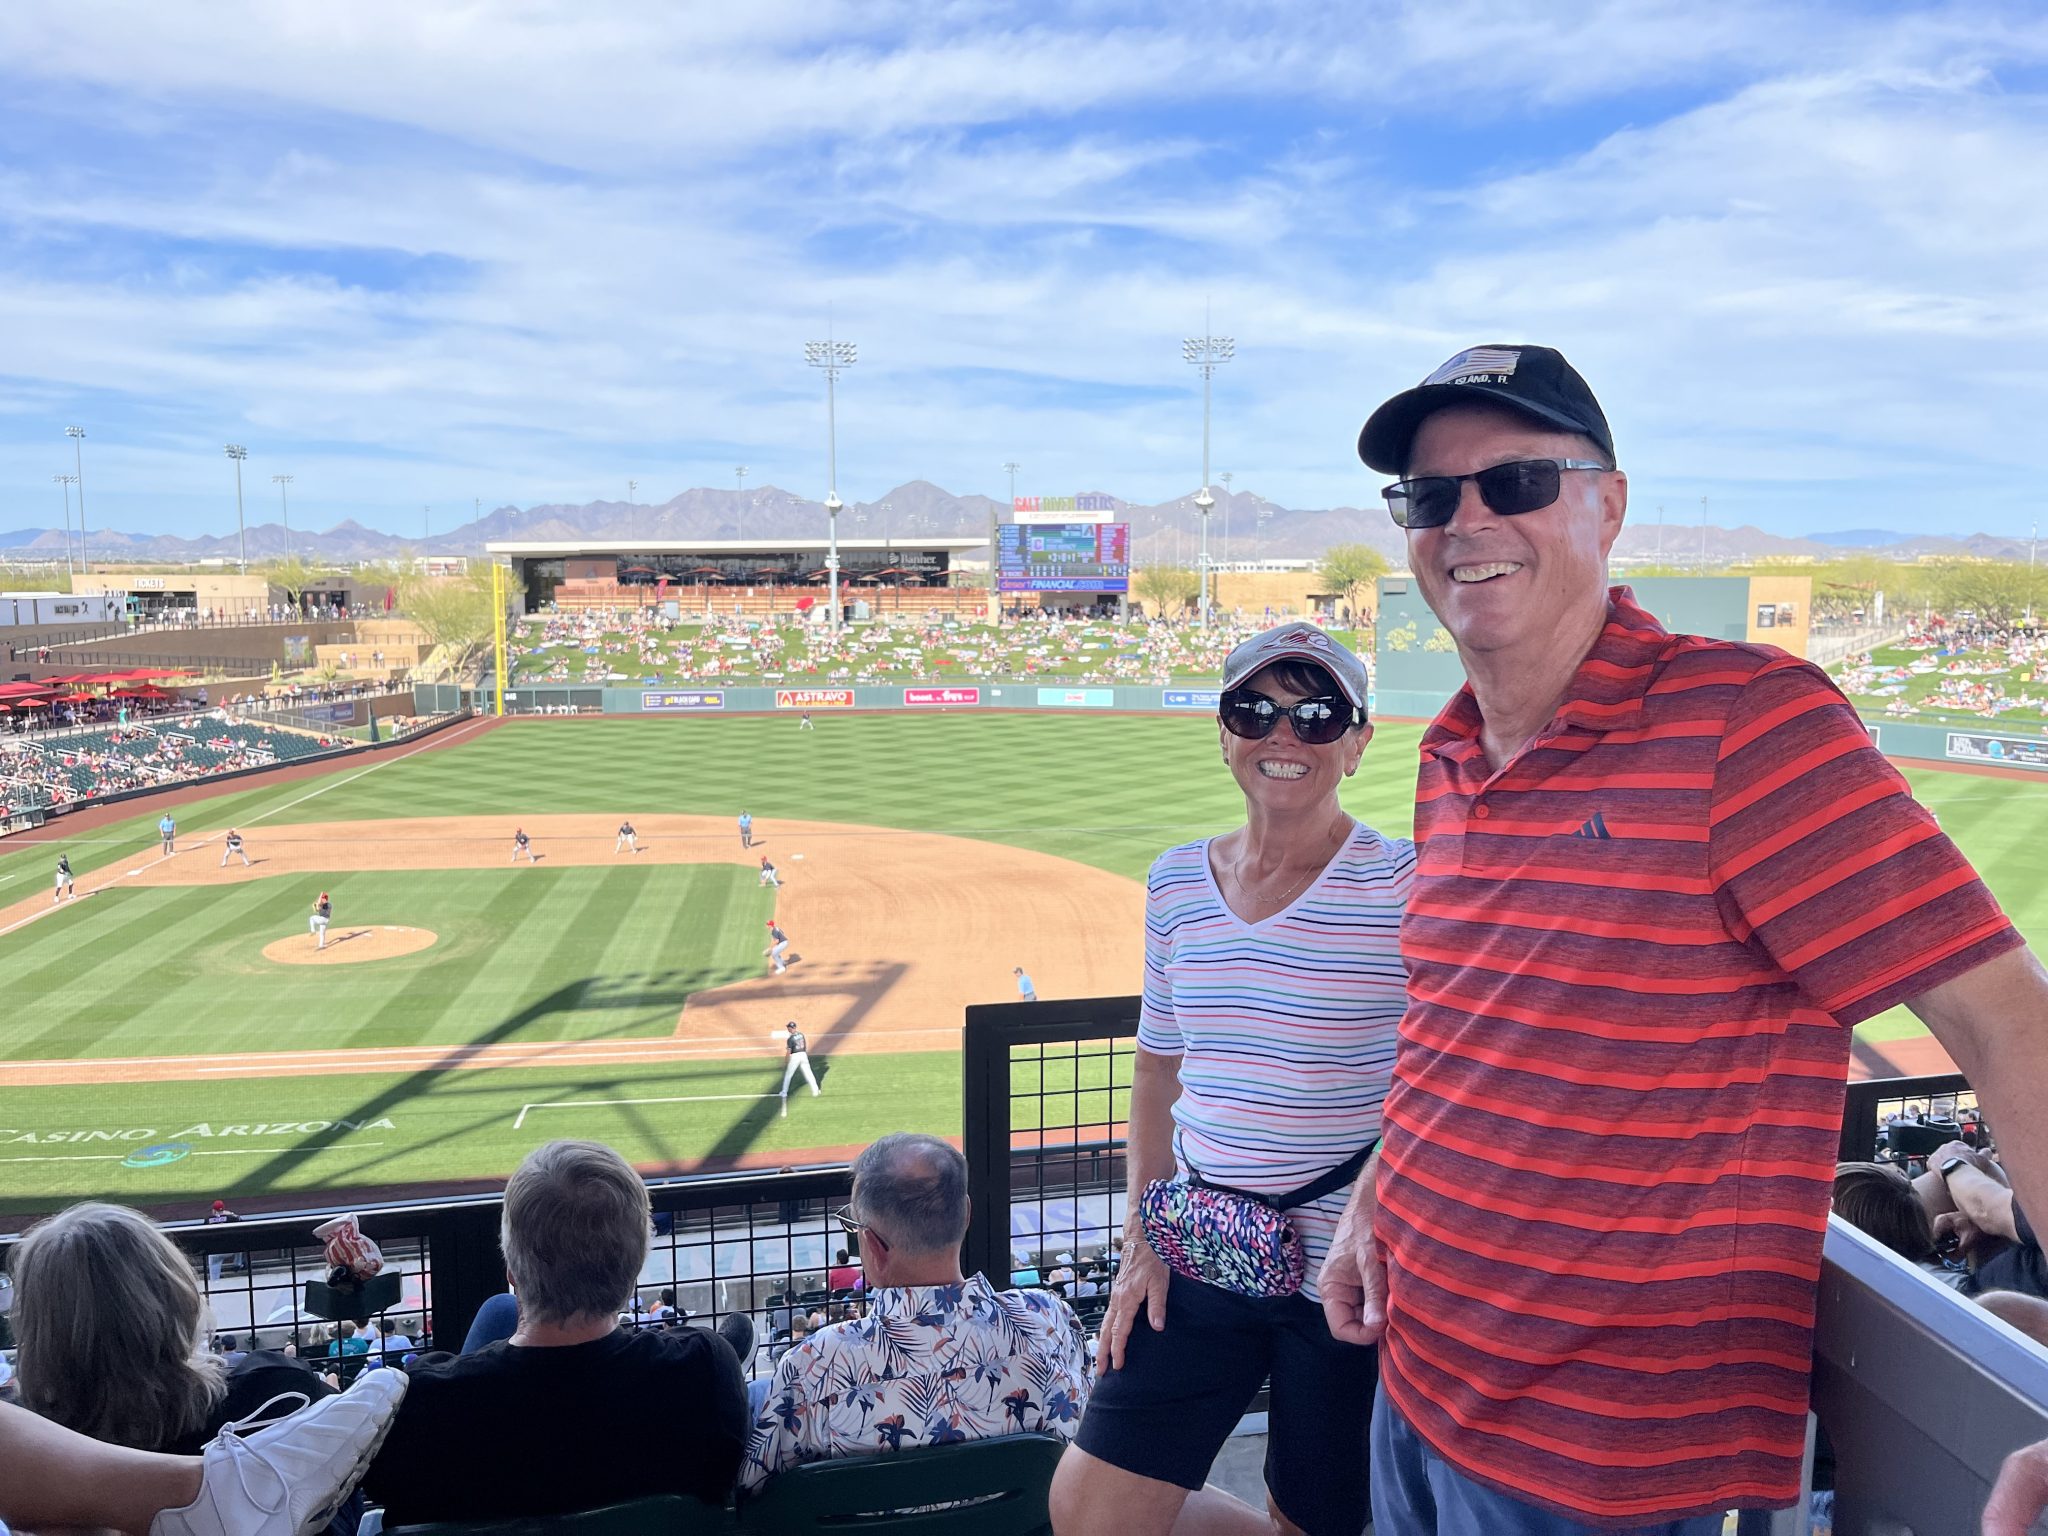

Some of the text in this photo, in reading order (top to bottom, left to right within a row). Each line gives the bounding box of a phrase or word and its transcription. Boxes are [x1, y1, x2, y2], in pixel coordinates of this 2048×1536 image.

[1014, 495, 1114, 511] SALT RIVER FIELDS
[900, 554, 936, 564] Banner
[135, 578, 165, 588] TICKETS
[796, 692, 847, 701] ASTRAVO
[167, 1118, 397, 1139] ARIZONA
